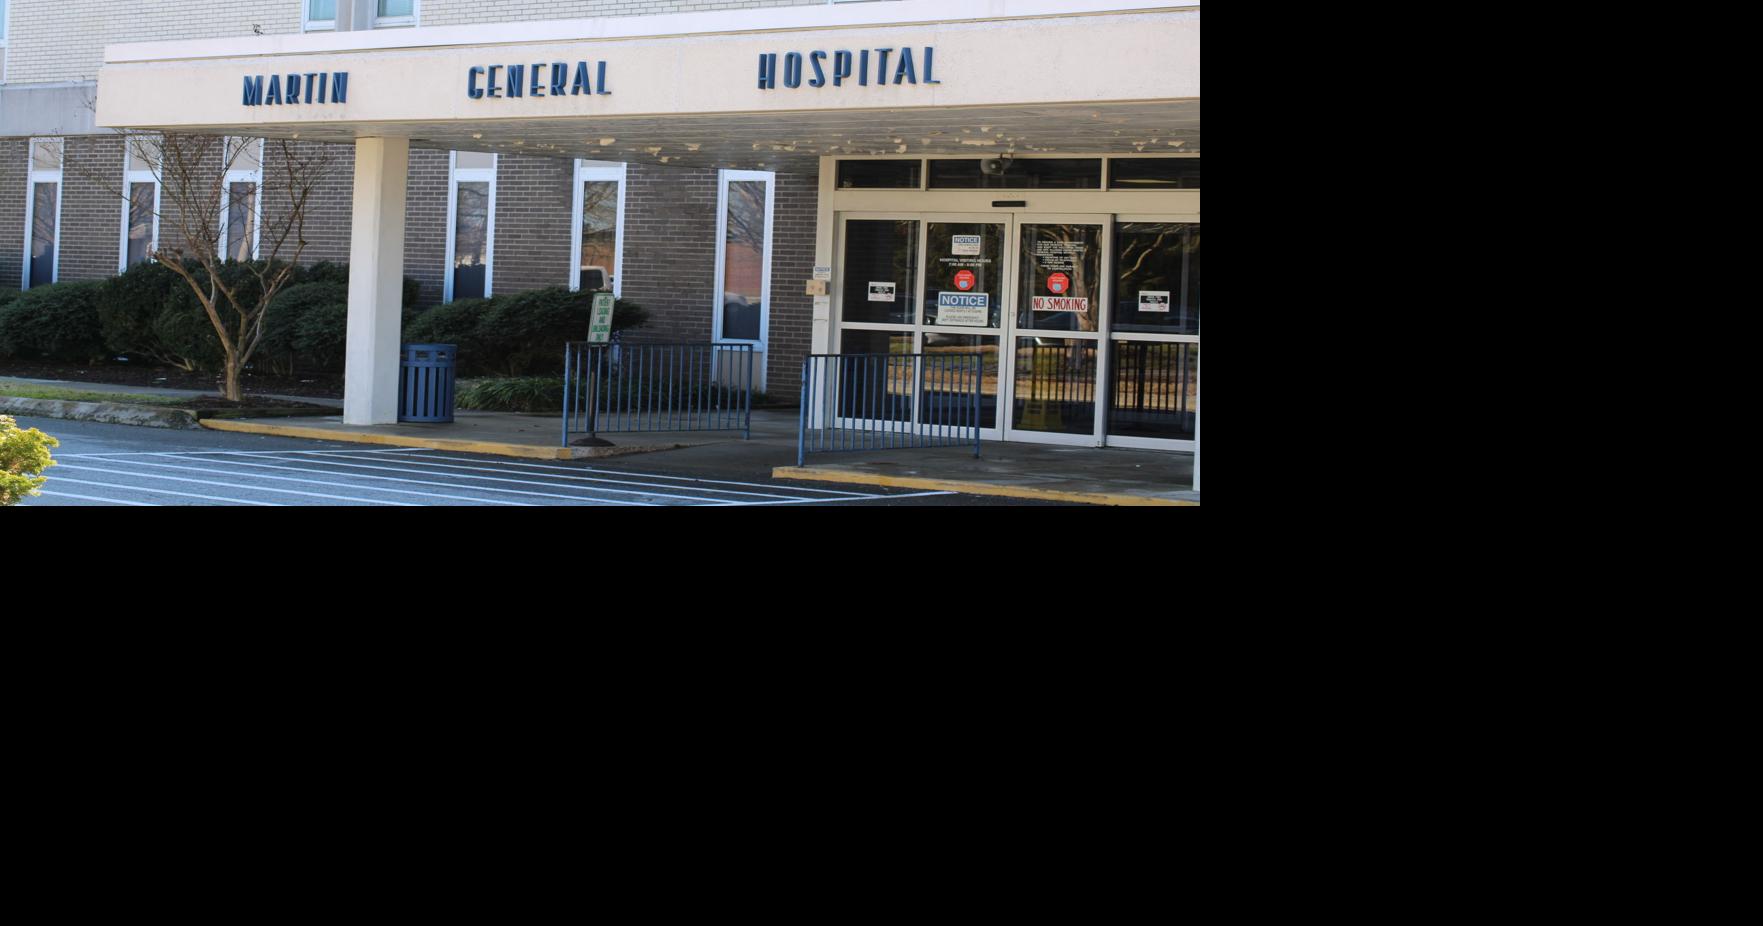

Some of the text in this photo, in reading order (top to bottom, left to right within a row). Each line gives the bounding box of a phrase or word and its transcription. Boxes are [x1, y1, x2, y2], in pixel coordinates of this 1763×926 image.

[243, 46, 941, 107] MARTIN GENERAL HOSPITAL
[942, 296, 985, 305] NOTICE
[1033, 297, 1087, 311] NO SMOKING
